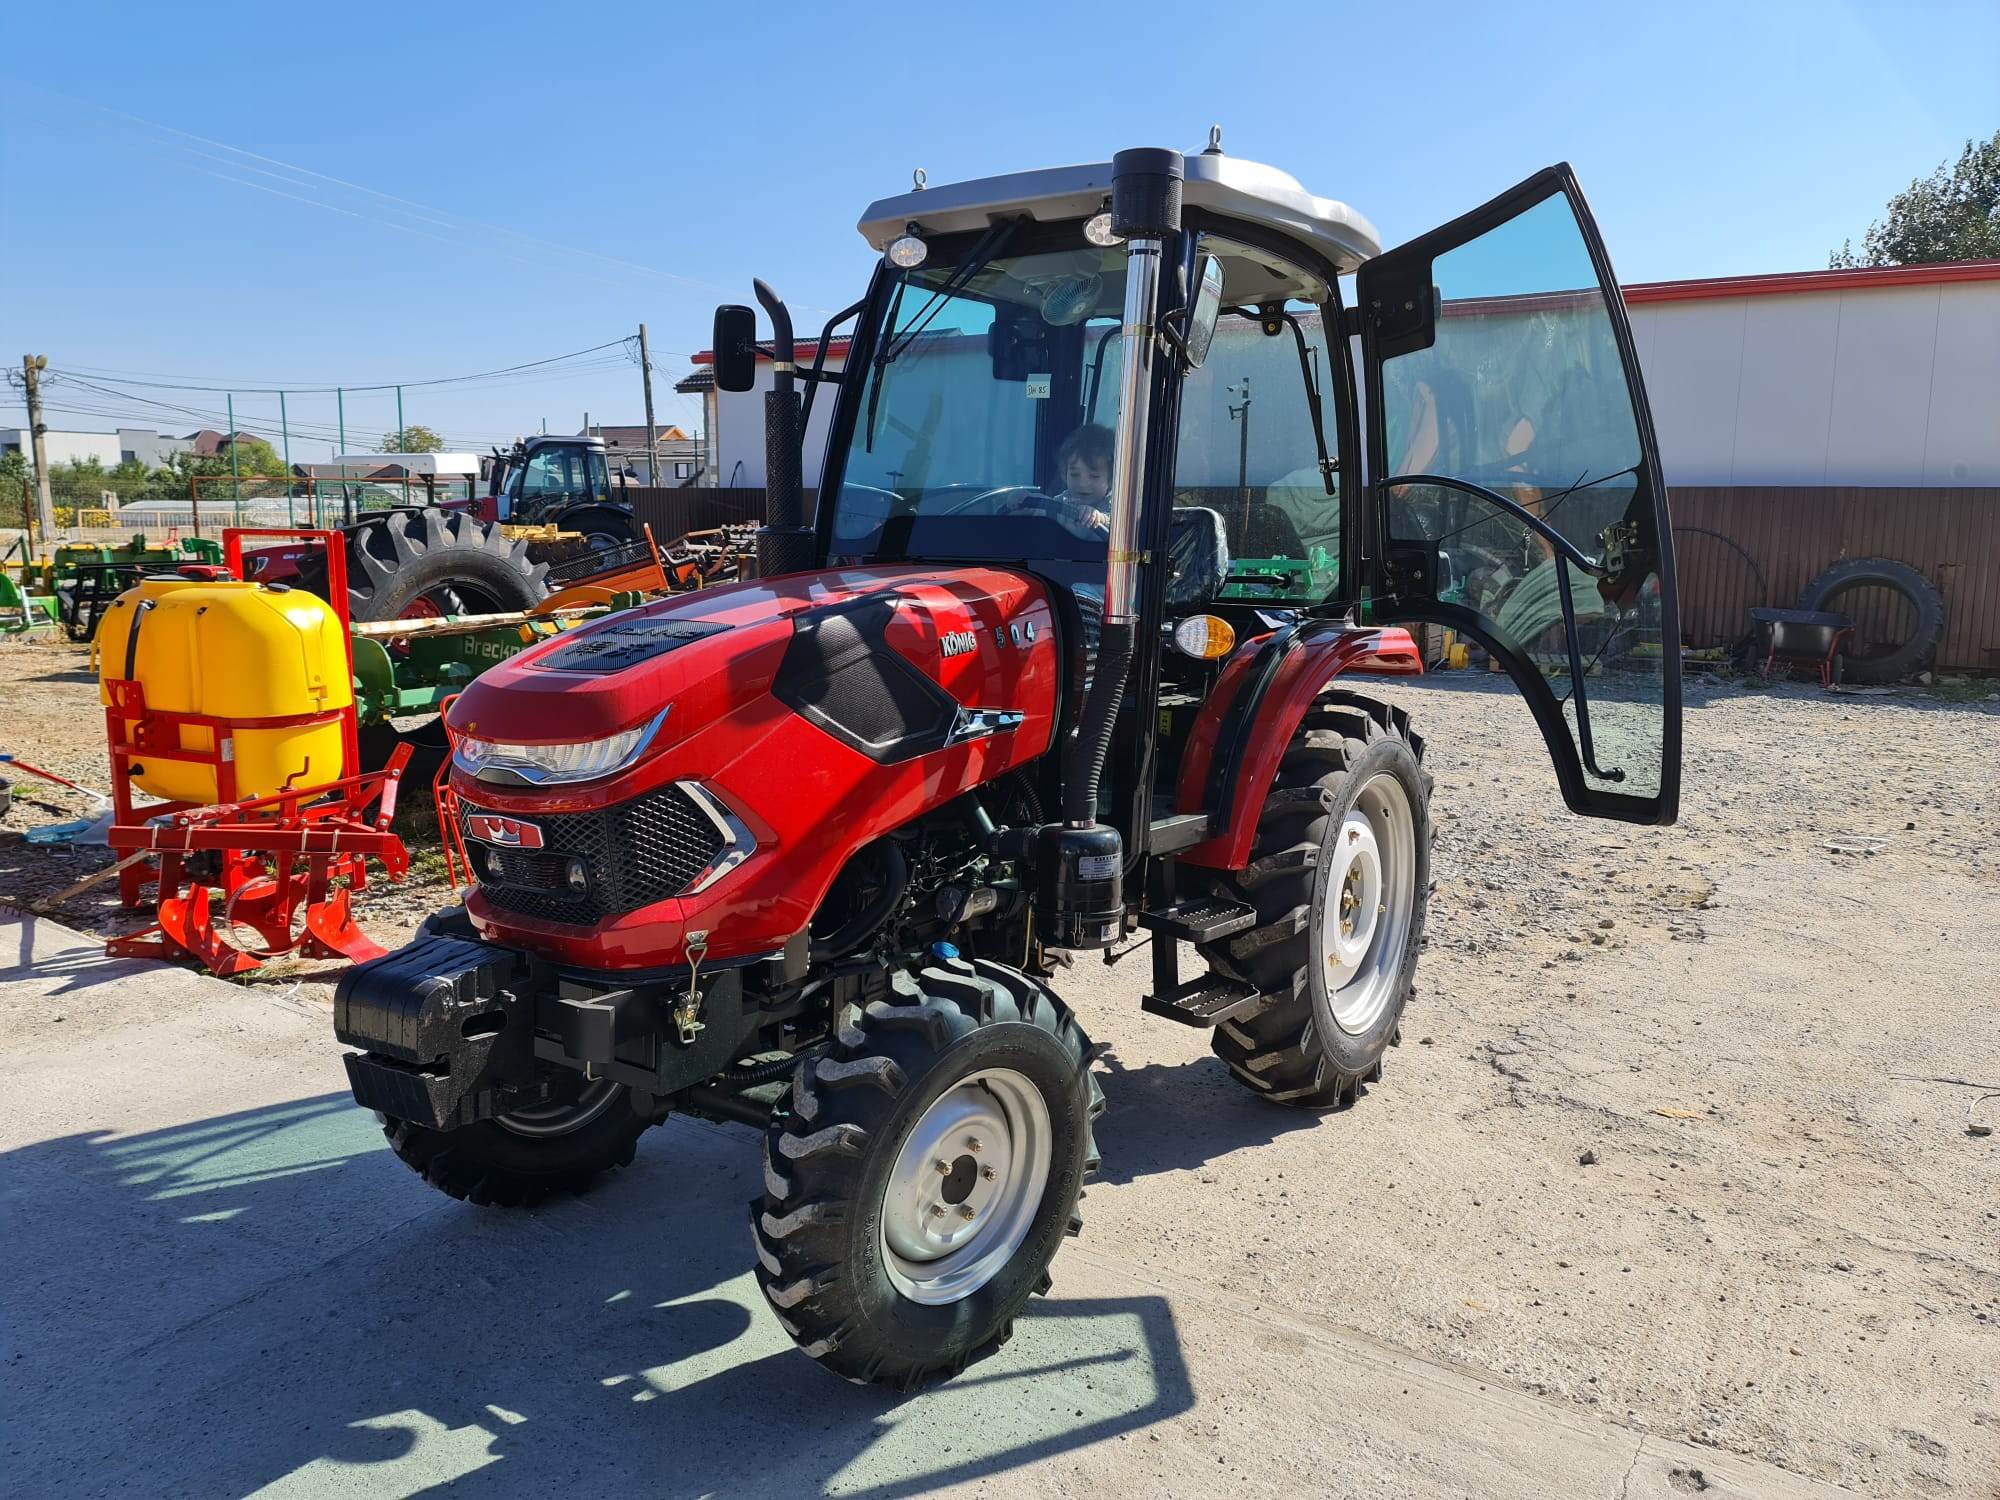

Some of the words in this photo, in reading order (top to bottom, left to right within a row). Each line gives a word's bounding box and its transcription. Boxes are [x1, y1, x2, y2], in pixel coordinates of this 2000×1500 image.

[463, 635, 526, 659] Breckn
[939, 630, 977, 658] KÖNIG
[994, 621, 1035, 649] 504
